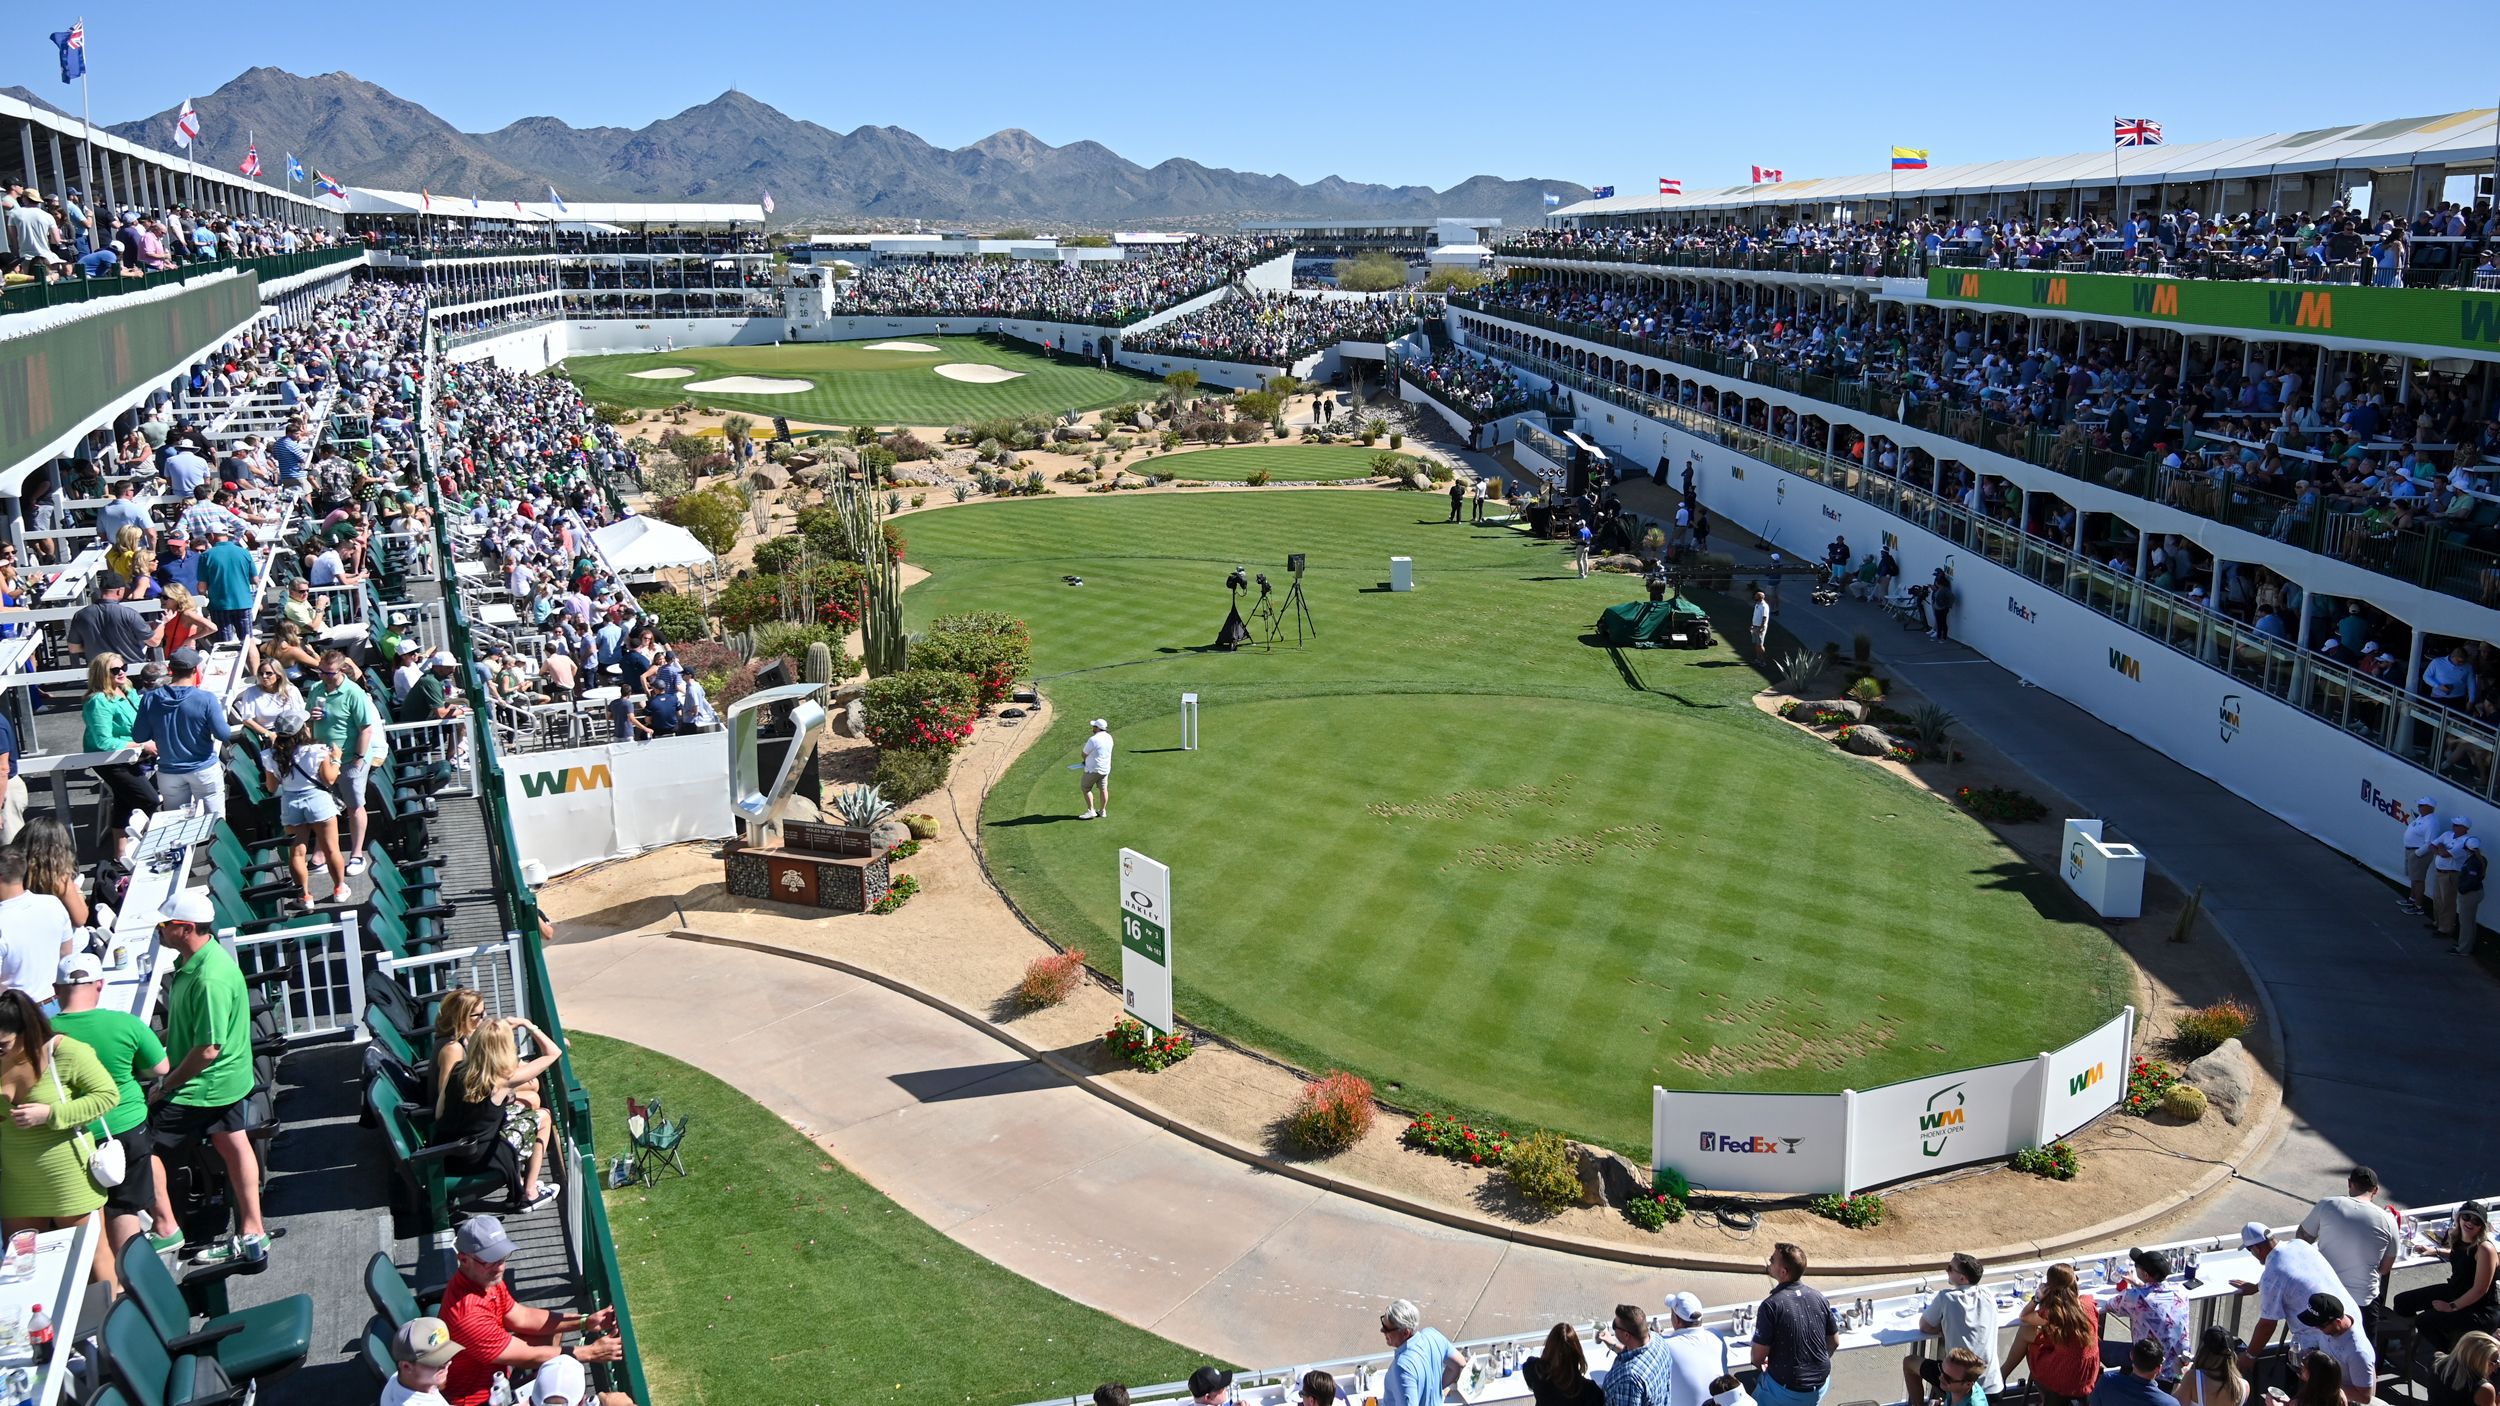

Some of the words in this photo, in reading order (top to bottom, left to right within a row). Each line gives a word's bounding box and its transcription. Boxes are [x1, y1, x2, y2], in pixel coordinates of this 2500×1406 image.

[1946, 273, 1979, 298] WM
[2032, 278, 2067, 305] WM
[2133, 283, 2177, 316] WM
[2269, 290, 2332, 329] WM
[2461, 300, 2500, 342] W
[1731, 465, 1744, 481] WM
[1882, 529, 1898, 551] WM
[2013, 601, 2030, 621] FedEx
[2109, 647, 2140, 682] WM
[2219, 706, 2240, 728] WM
[519, 764, 613, 799] WM
[2372, 788, 2410, 826] FedEx
[1125, 900, 1159, 920] OAKLEY
[1124, 917, 1142, 940] 16
[2070, 1062, 2103, 1097] WM
[1919, 1108, 1964, 1131] WM
[1720, 1135, 1778, 1153] FedEx
[1920, 1128, 1947, 1140] PHOENIX
[1946, 1125, 1965, 1134] OPEN
